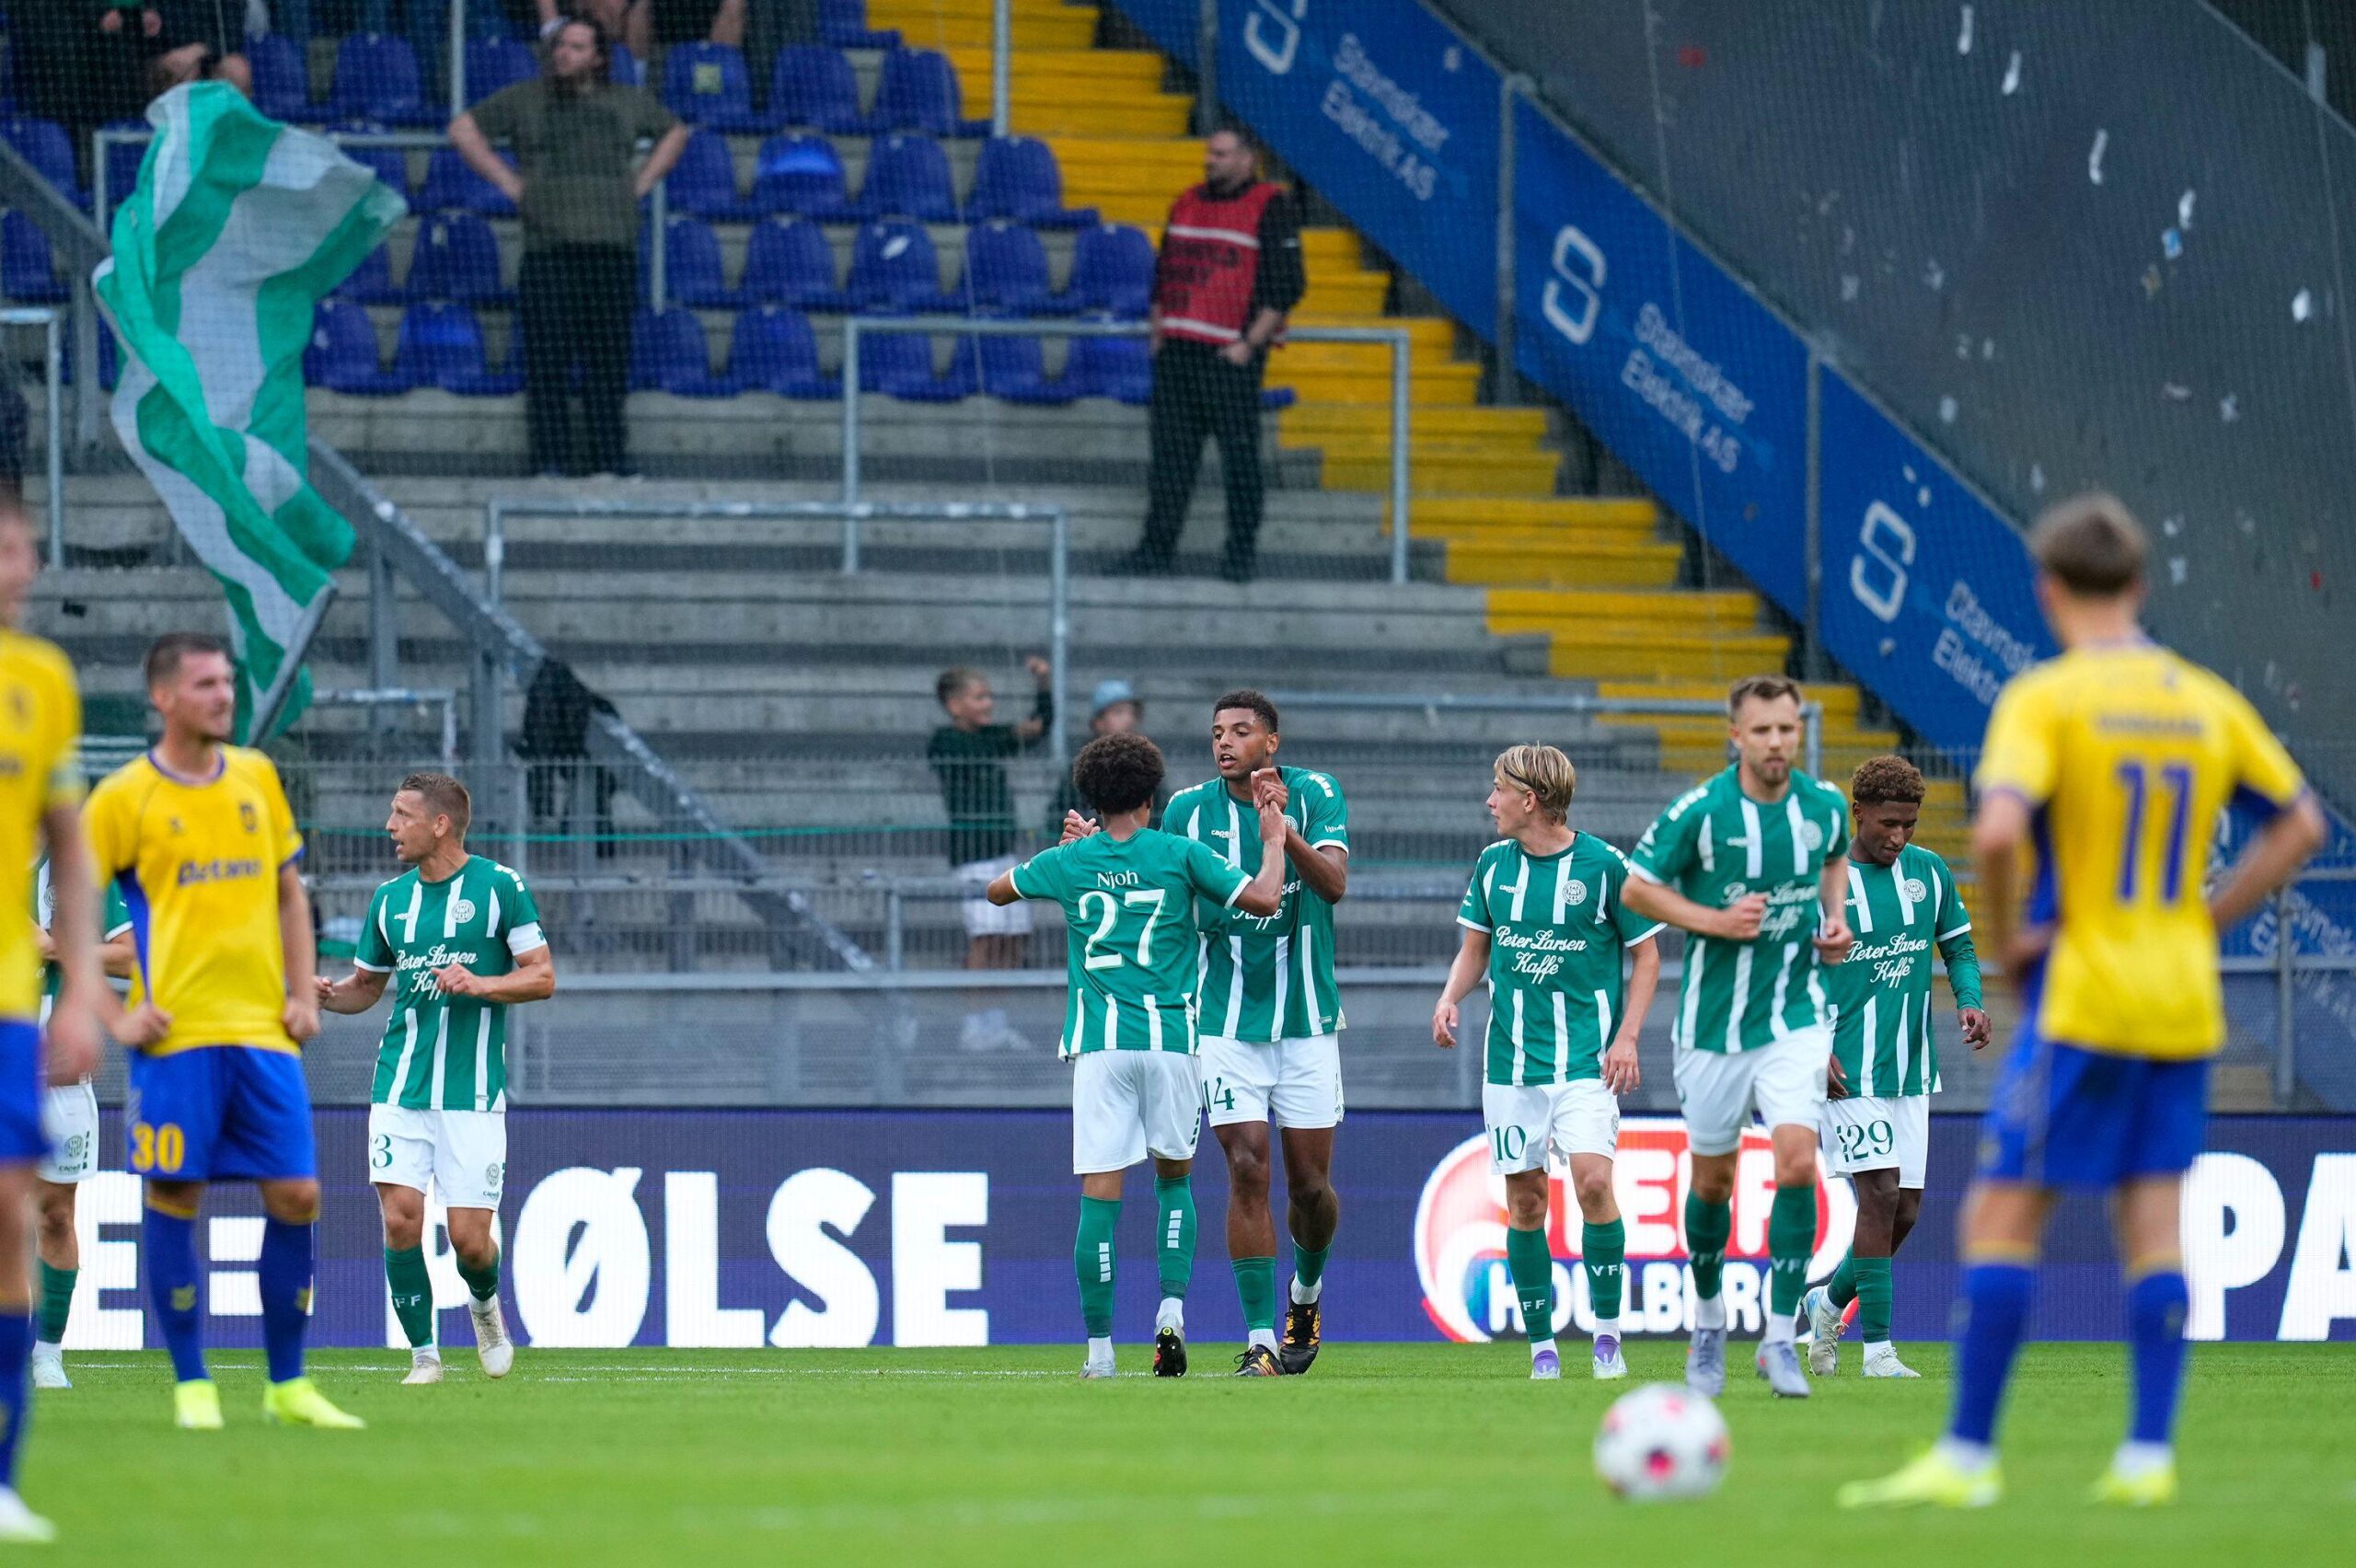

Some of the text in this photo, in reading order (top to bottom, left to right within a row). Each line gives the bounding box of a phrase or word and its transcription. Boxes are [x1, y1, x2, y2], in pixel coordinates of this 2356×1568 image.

[2117, 758, 2193, 902] 11
[1096, 870, 1139, 890] Njoh
[1078, 889, 1169, 972] 27
[1496, 925, 1588, 951] Peter Larsen
[396, 943, 479, 972] Peter Larsen
[1842, 940, 1889, 963] Peter
[1204, 1077, 1236, 1114] 14
[131, 1122, 185, 1174] 30
[371, 1134, 394, 1169] 3
[1494, 1124, 1527, 1161] 10
[1846, 1119, 1894, 1160] 29
[2180, 1151, 2356, 1342] PA
[394, 1294, 422, 1309] FF
[1519, 1298, 1546, 1311] FF
